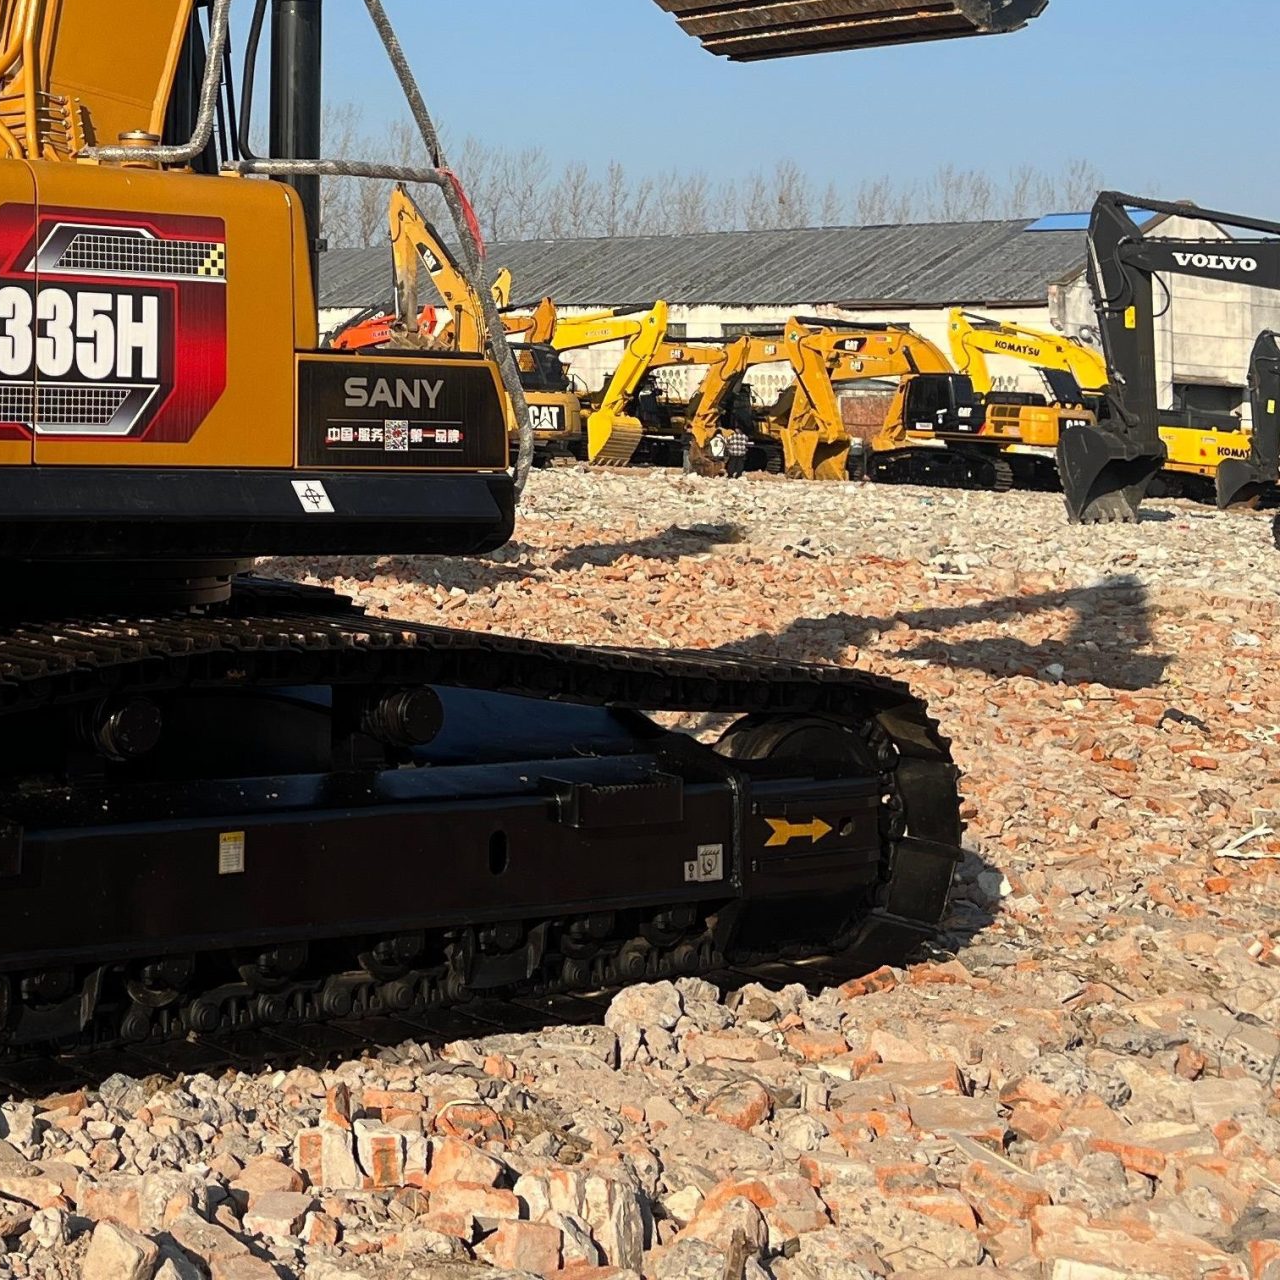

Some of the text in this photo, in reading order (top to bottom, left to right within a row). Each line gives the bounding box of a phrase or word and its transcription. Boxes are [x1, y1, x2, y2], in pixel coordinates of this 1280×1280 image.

[1172, 252, 1257, 271] VOLVO
[995, 339, 1040, 357] KOMATSU
[344, 377, 444, 408] SANY
[528, 405, 560, 429] CAT
[1217, 446, 1251, 458] KOMAT
